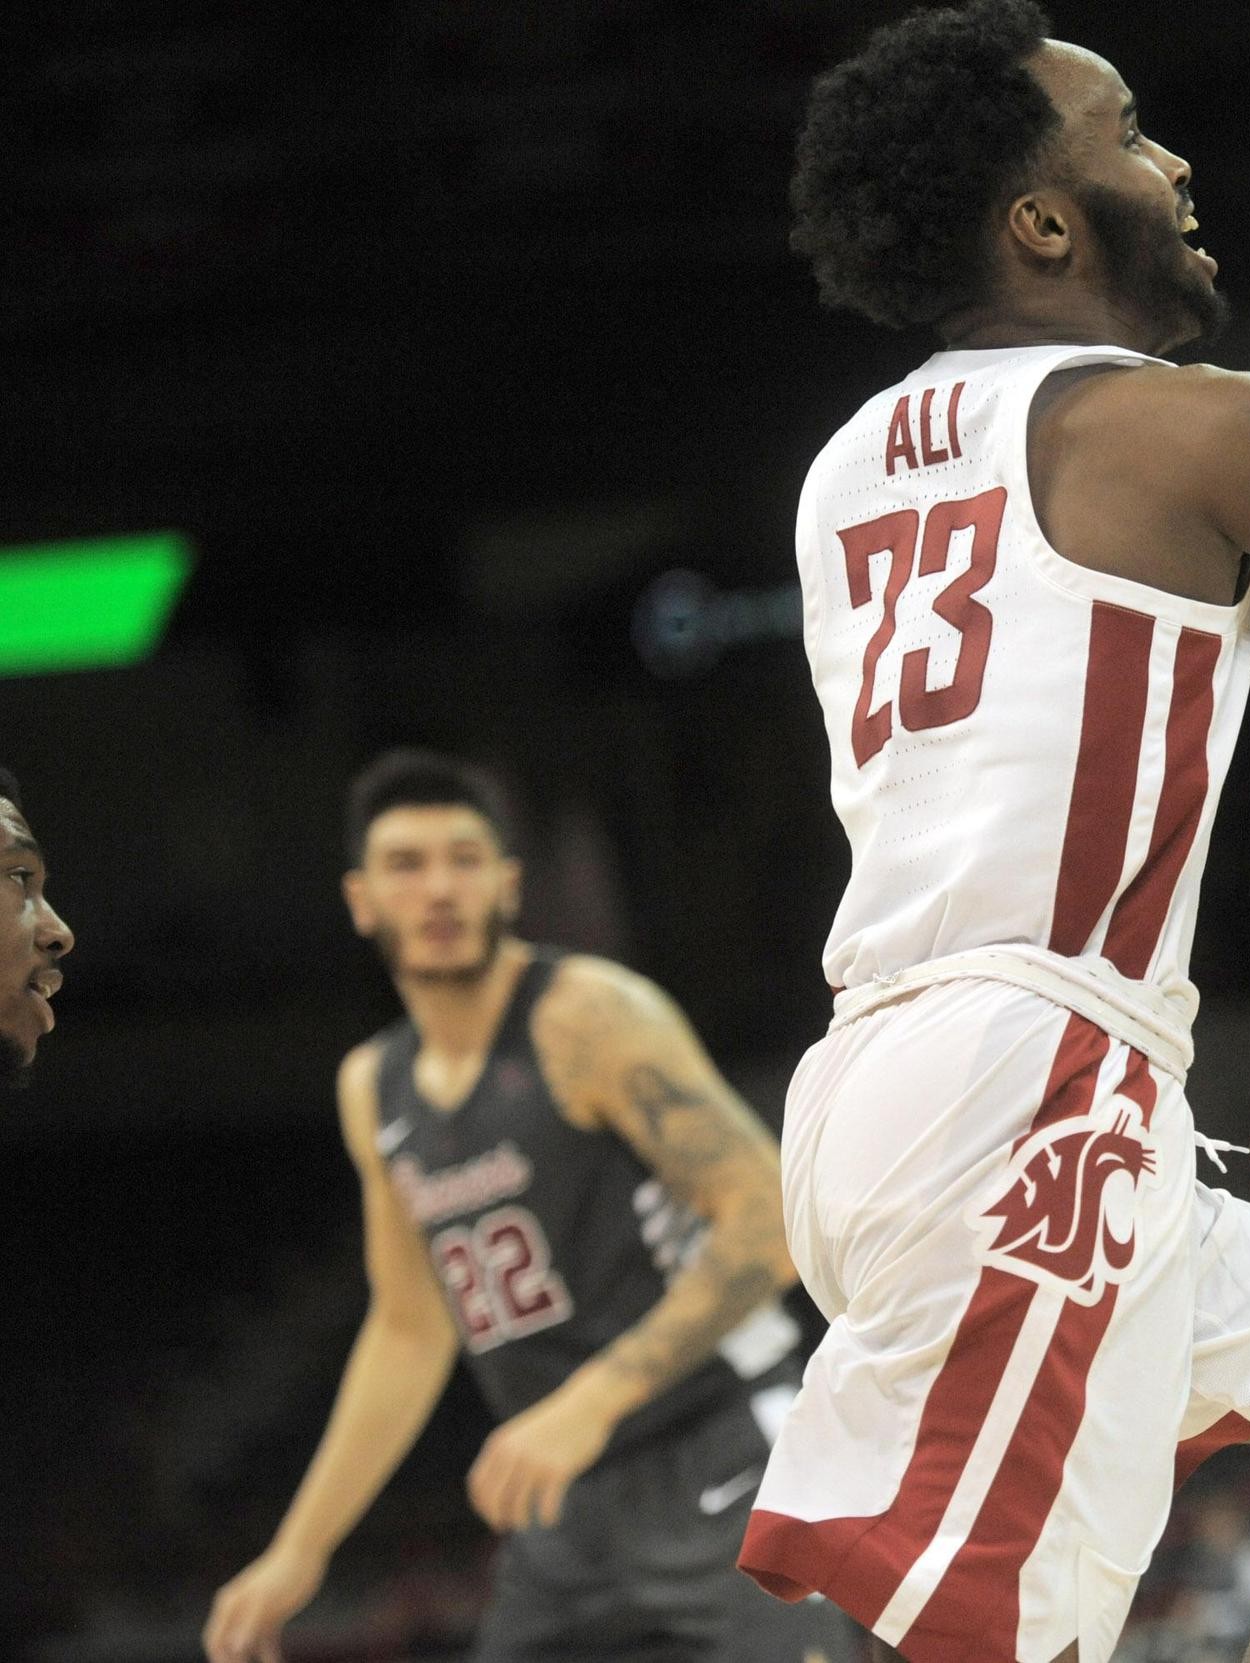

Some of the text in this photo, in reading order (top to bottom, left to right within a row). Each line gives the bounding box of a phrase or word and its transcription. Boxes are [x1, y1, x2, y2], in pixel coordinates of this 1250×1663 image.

[886, 381, 965, 476] ALI
[836, 486, 1008, 769] 23
[431, 1205, 575, 1355] 22
